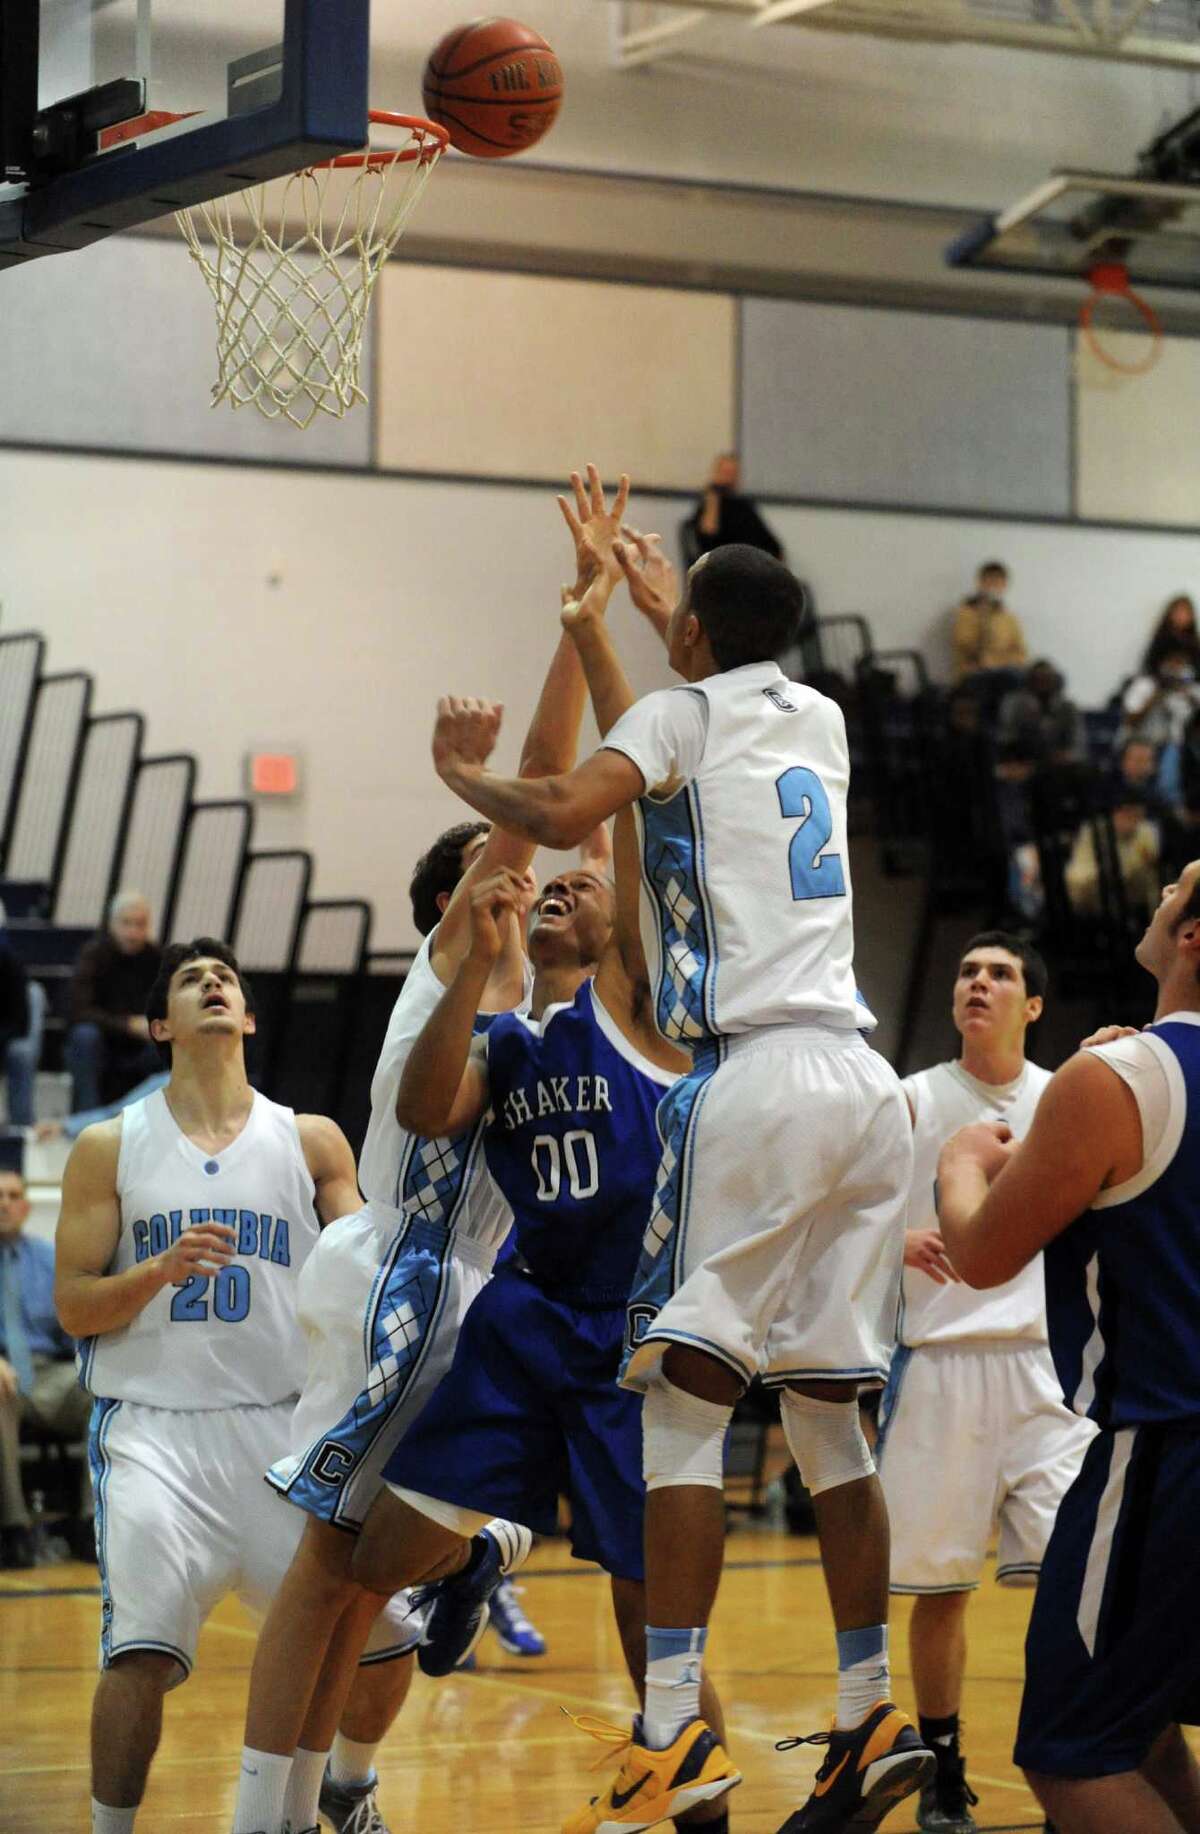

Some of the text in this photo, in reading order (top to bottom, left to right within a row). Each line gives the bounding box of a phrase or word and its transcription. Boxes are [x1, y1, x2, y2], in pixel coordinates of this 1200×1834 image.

[775, 766, 846, 900] 2
[503, 1074, 613, 1130] SHAKER
[531, 1129, 599, 1201] 00
[170, 1264, 251, 1323] 20
[310, 1441, 353, 1486] C
